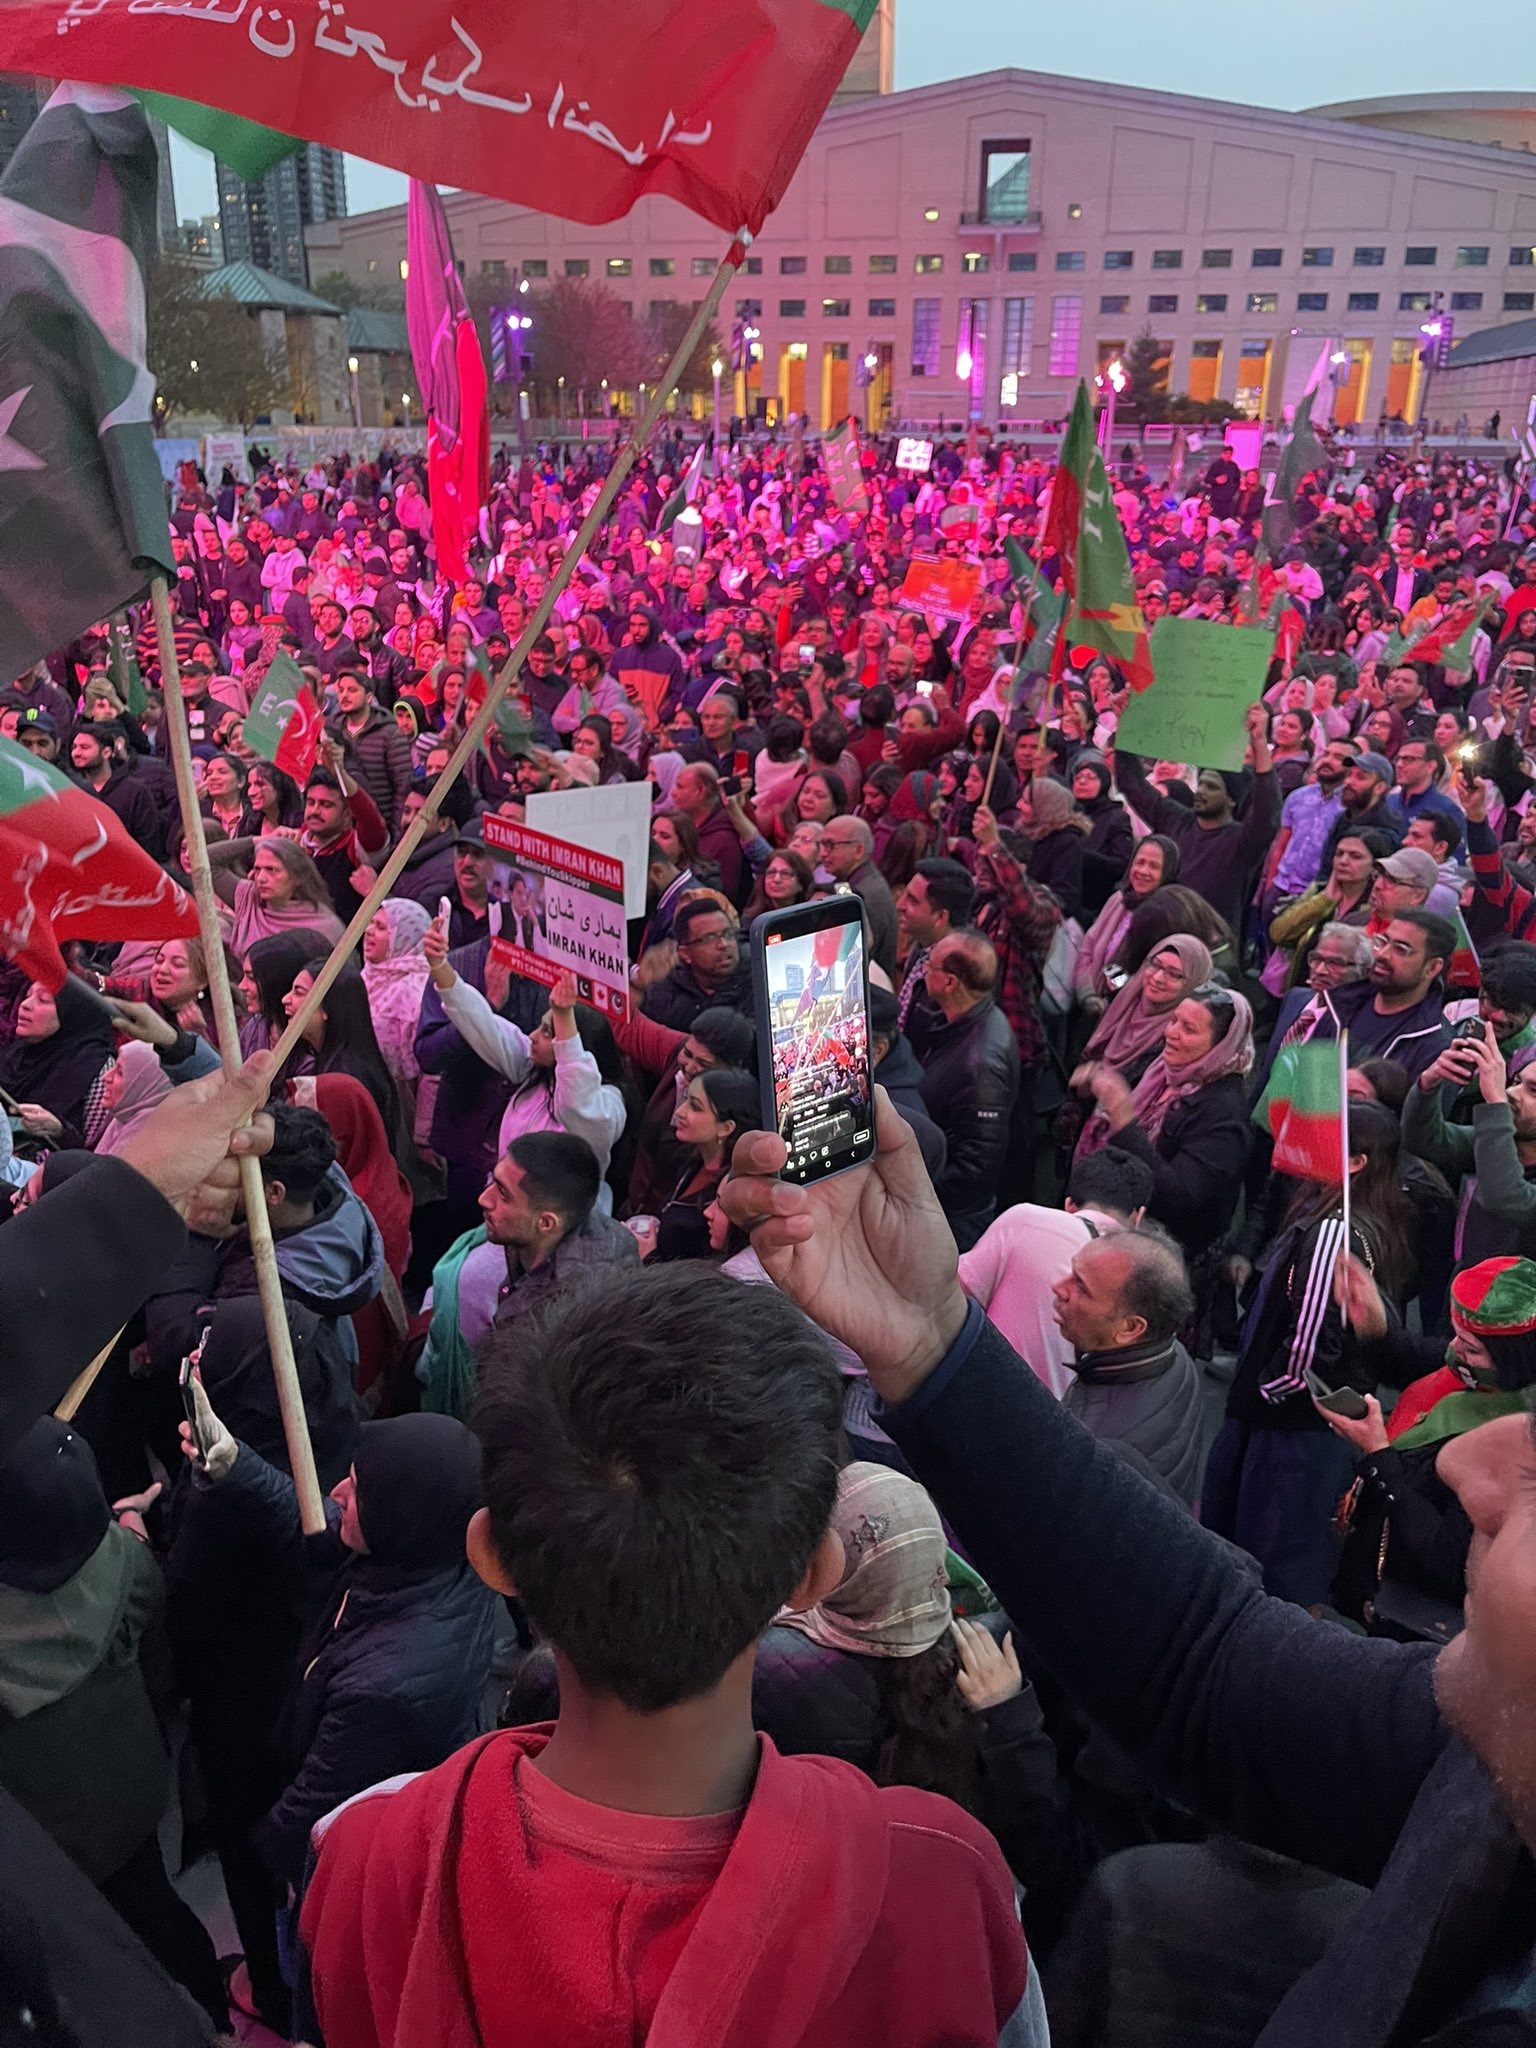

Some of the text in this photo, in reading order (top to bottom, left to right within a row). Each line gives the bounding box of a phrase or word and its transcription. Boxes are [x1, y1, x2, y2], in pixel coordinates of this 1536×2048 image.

[486, 822, 621, 886] STAND WITH IMRAN KHAN
[548, 929, 624, 976] IMRAN KHAN
